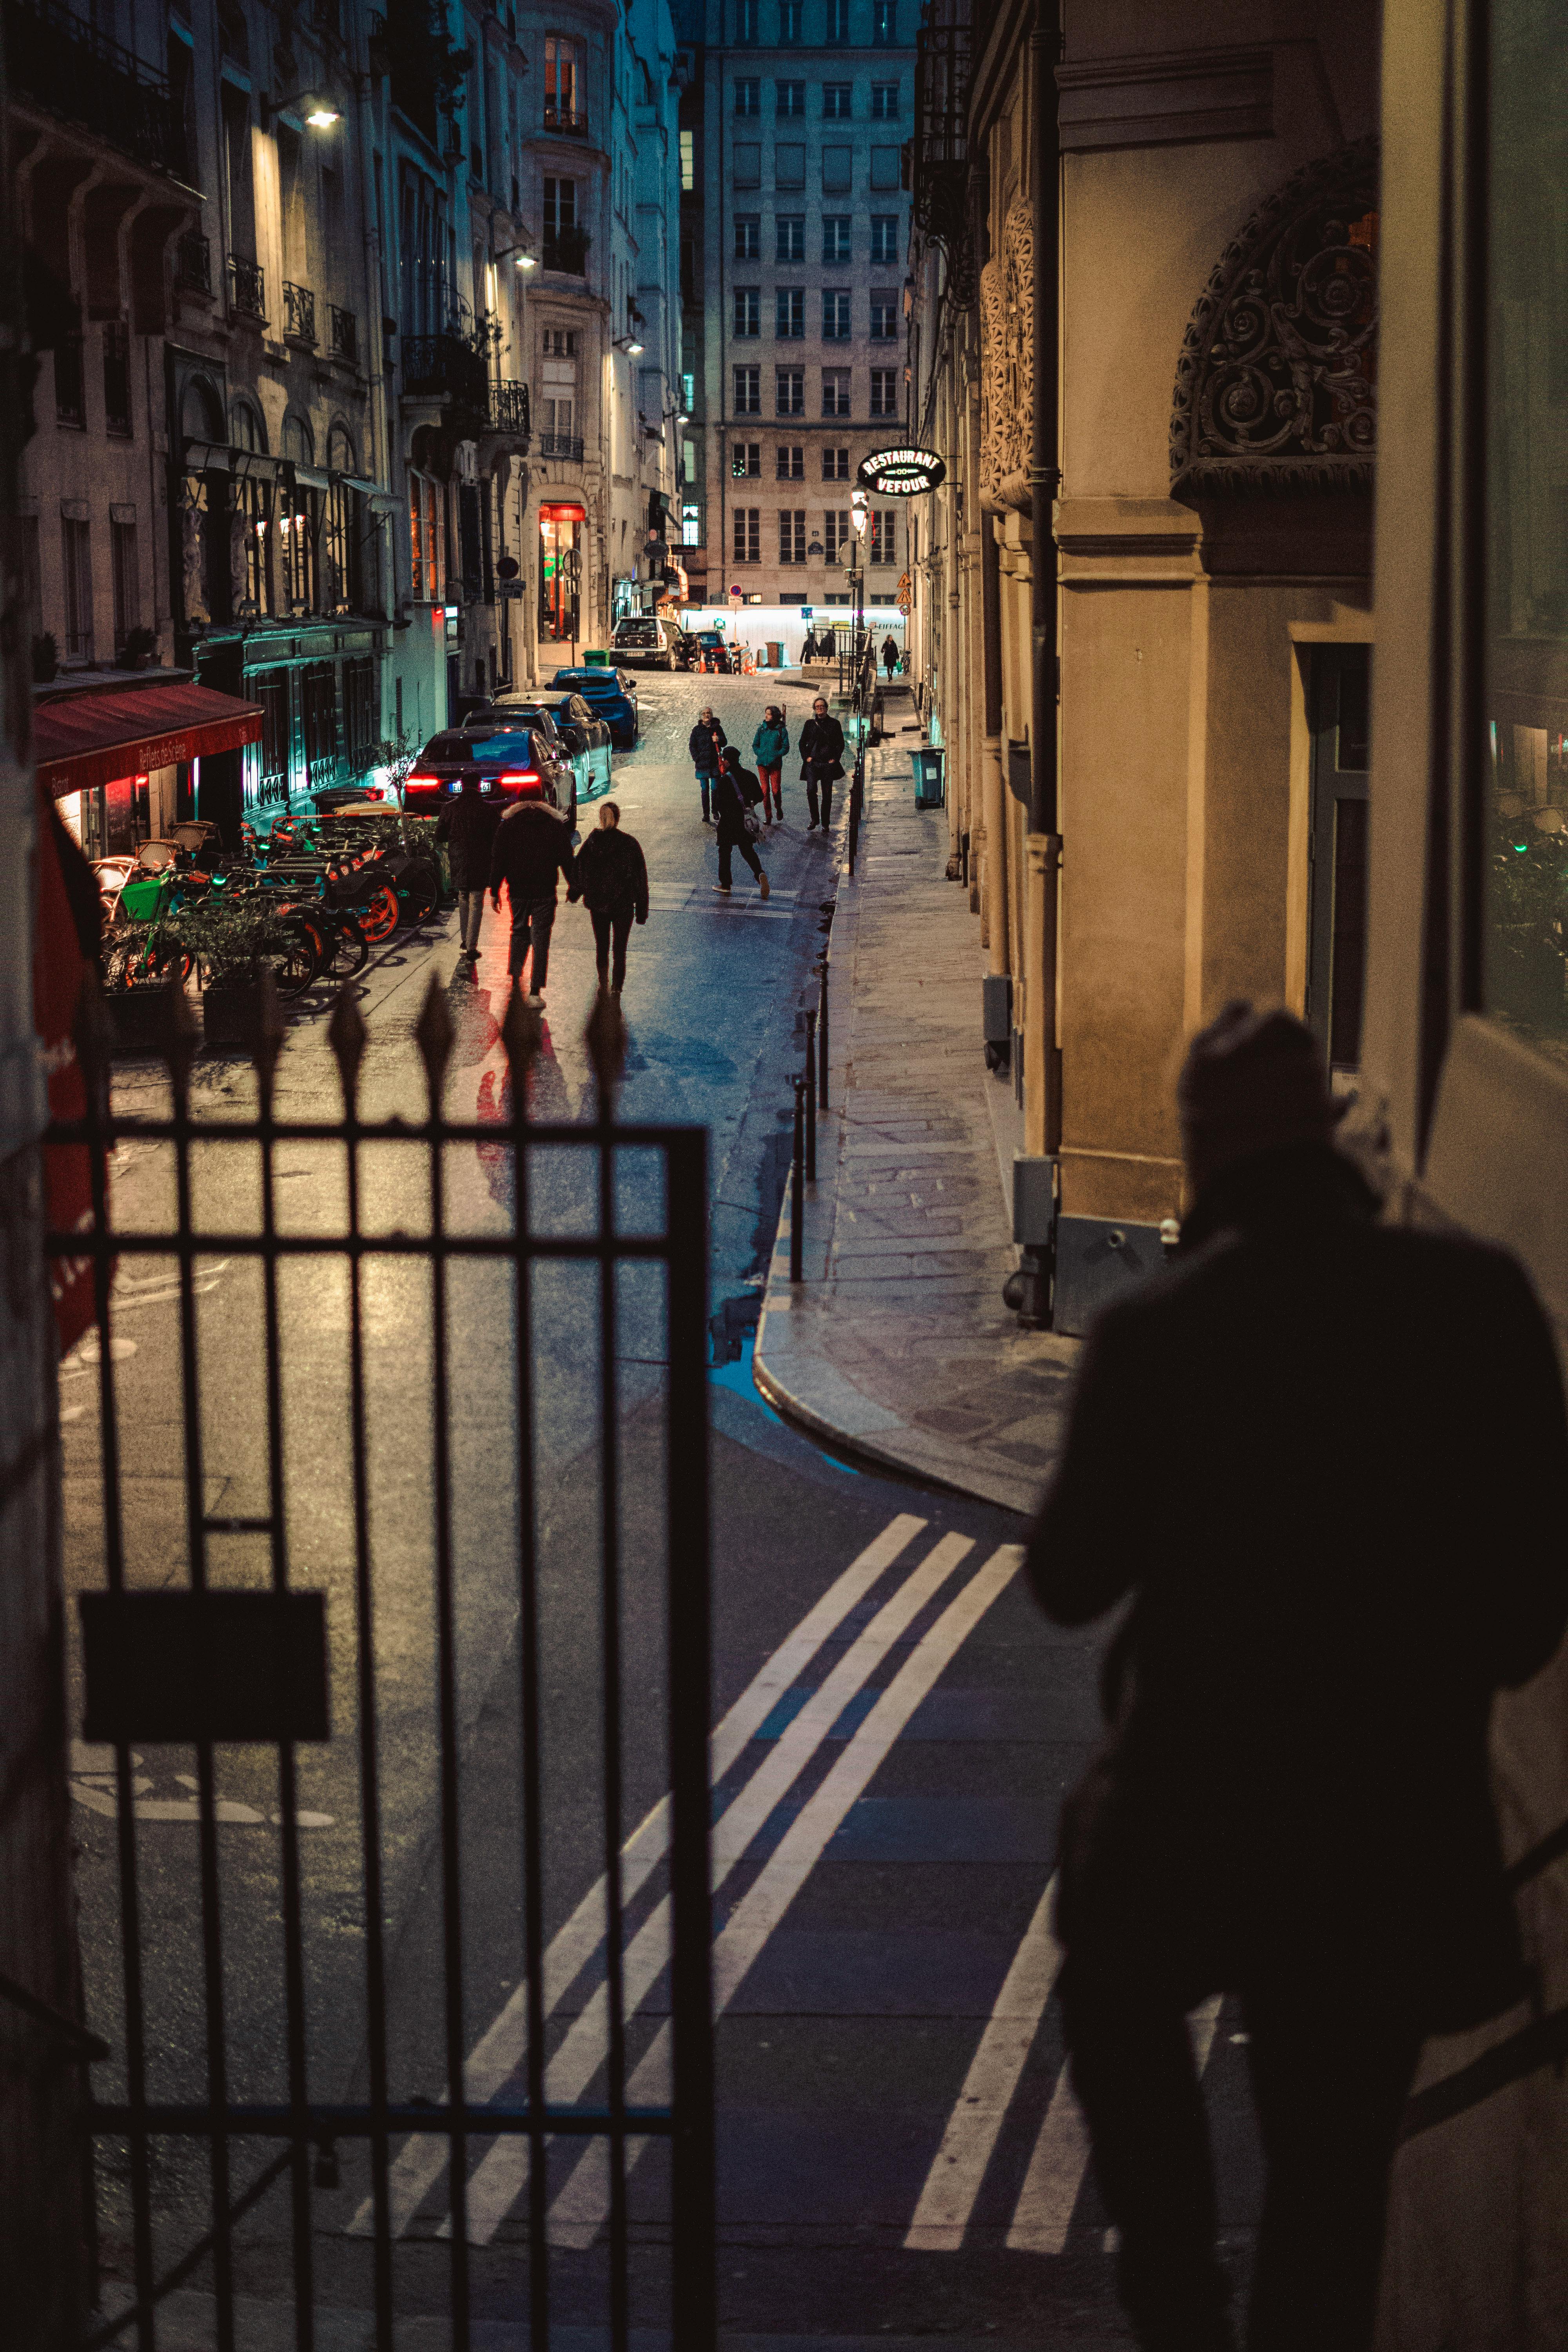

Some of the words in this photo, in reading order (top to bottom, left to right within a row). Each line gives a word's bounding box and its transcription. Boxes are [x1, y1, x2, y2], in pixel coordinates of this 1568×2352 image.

[862, 450, 940, 475] RESTAURANT
[877, 475, 930, 493] VEFOUR
[139, 745, 160, 771] Reflets
